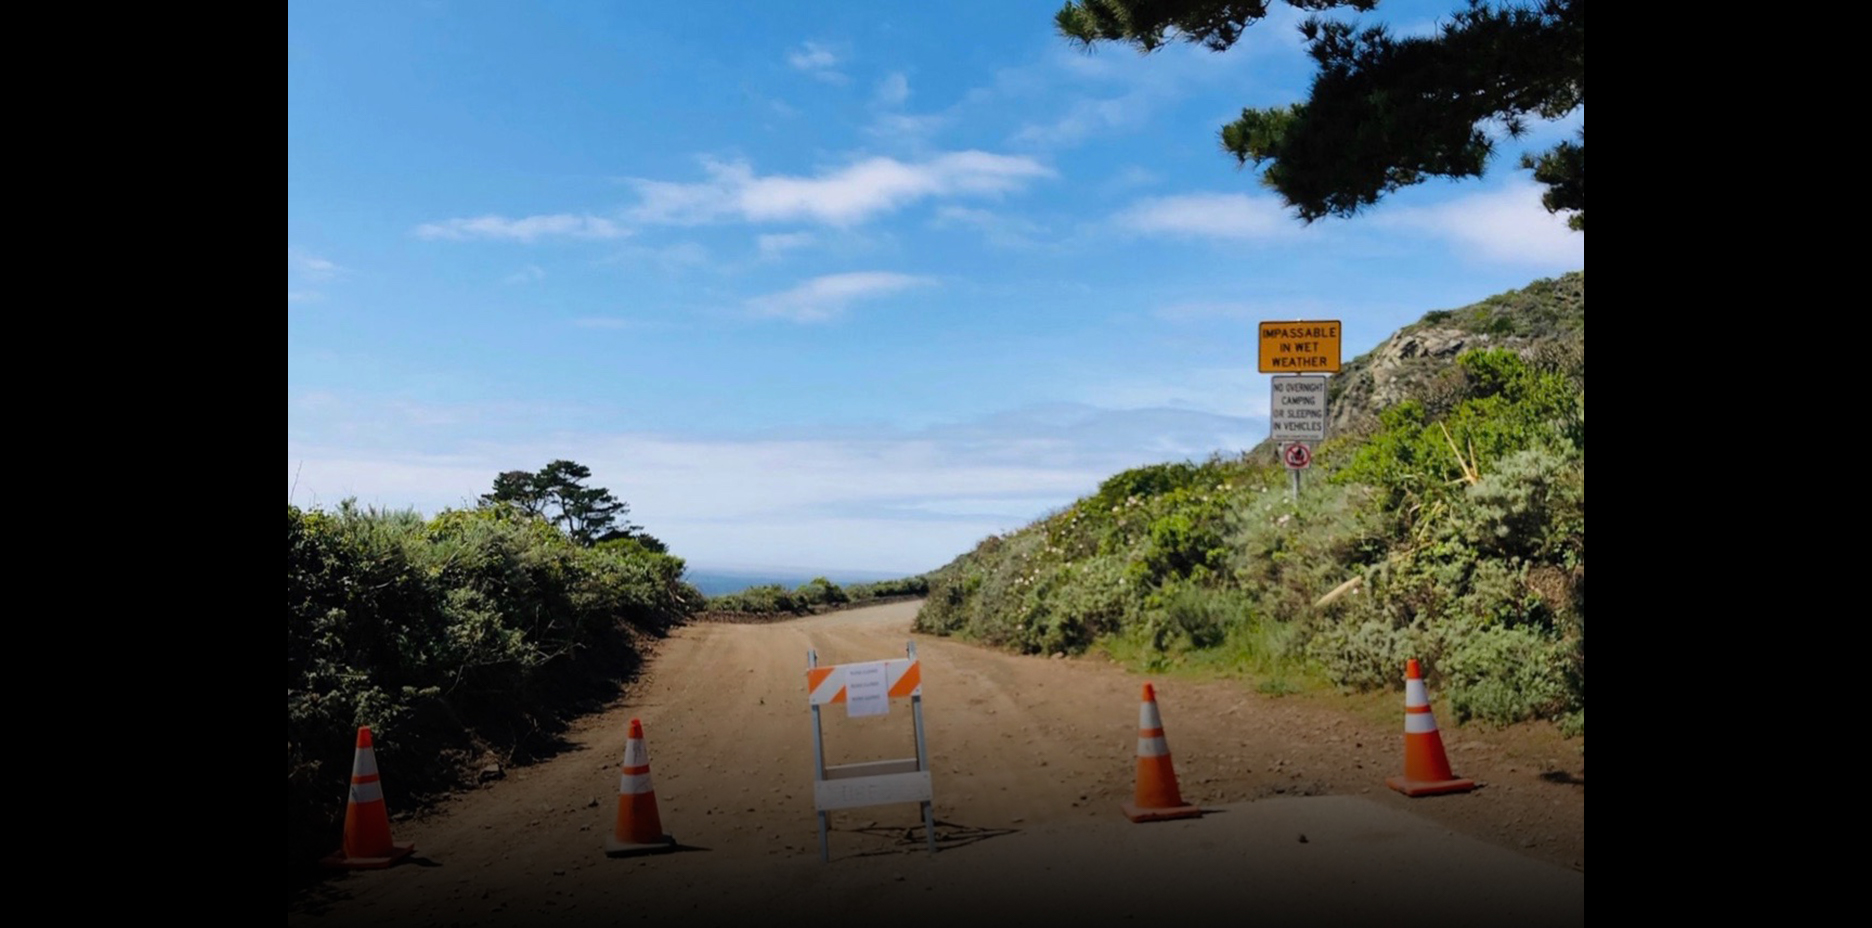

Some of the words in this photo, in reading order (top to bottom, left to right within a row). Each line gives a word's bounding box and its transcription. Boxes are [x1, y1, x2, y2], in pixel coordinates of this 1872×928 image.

[1262, 327, 1336, 338] IMPASSABLE
[1280, 342, 1291, 352] IN
[1295, 342, 1319, 352] WET
[1272, 357, 1327, 367] WEATHER
[1273, 383, 1283, 392] NO
[1286, 383, 1323, 392] OVERNIGHT
[1281, 396, 1316, 405] CAMPING
[1273, 409, 1284, 418] OR
[1287, 409, 1322, 418] SLEEPING
[1273, 421, 1281, 430] IN
[1283, 421, 1322, 431] VEHICLES
